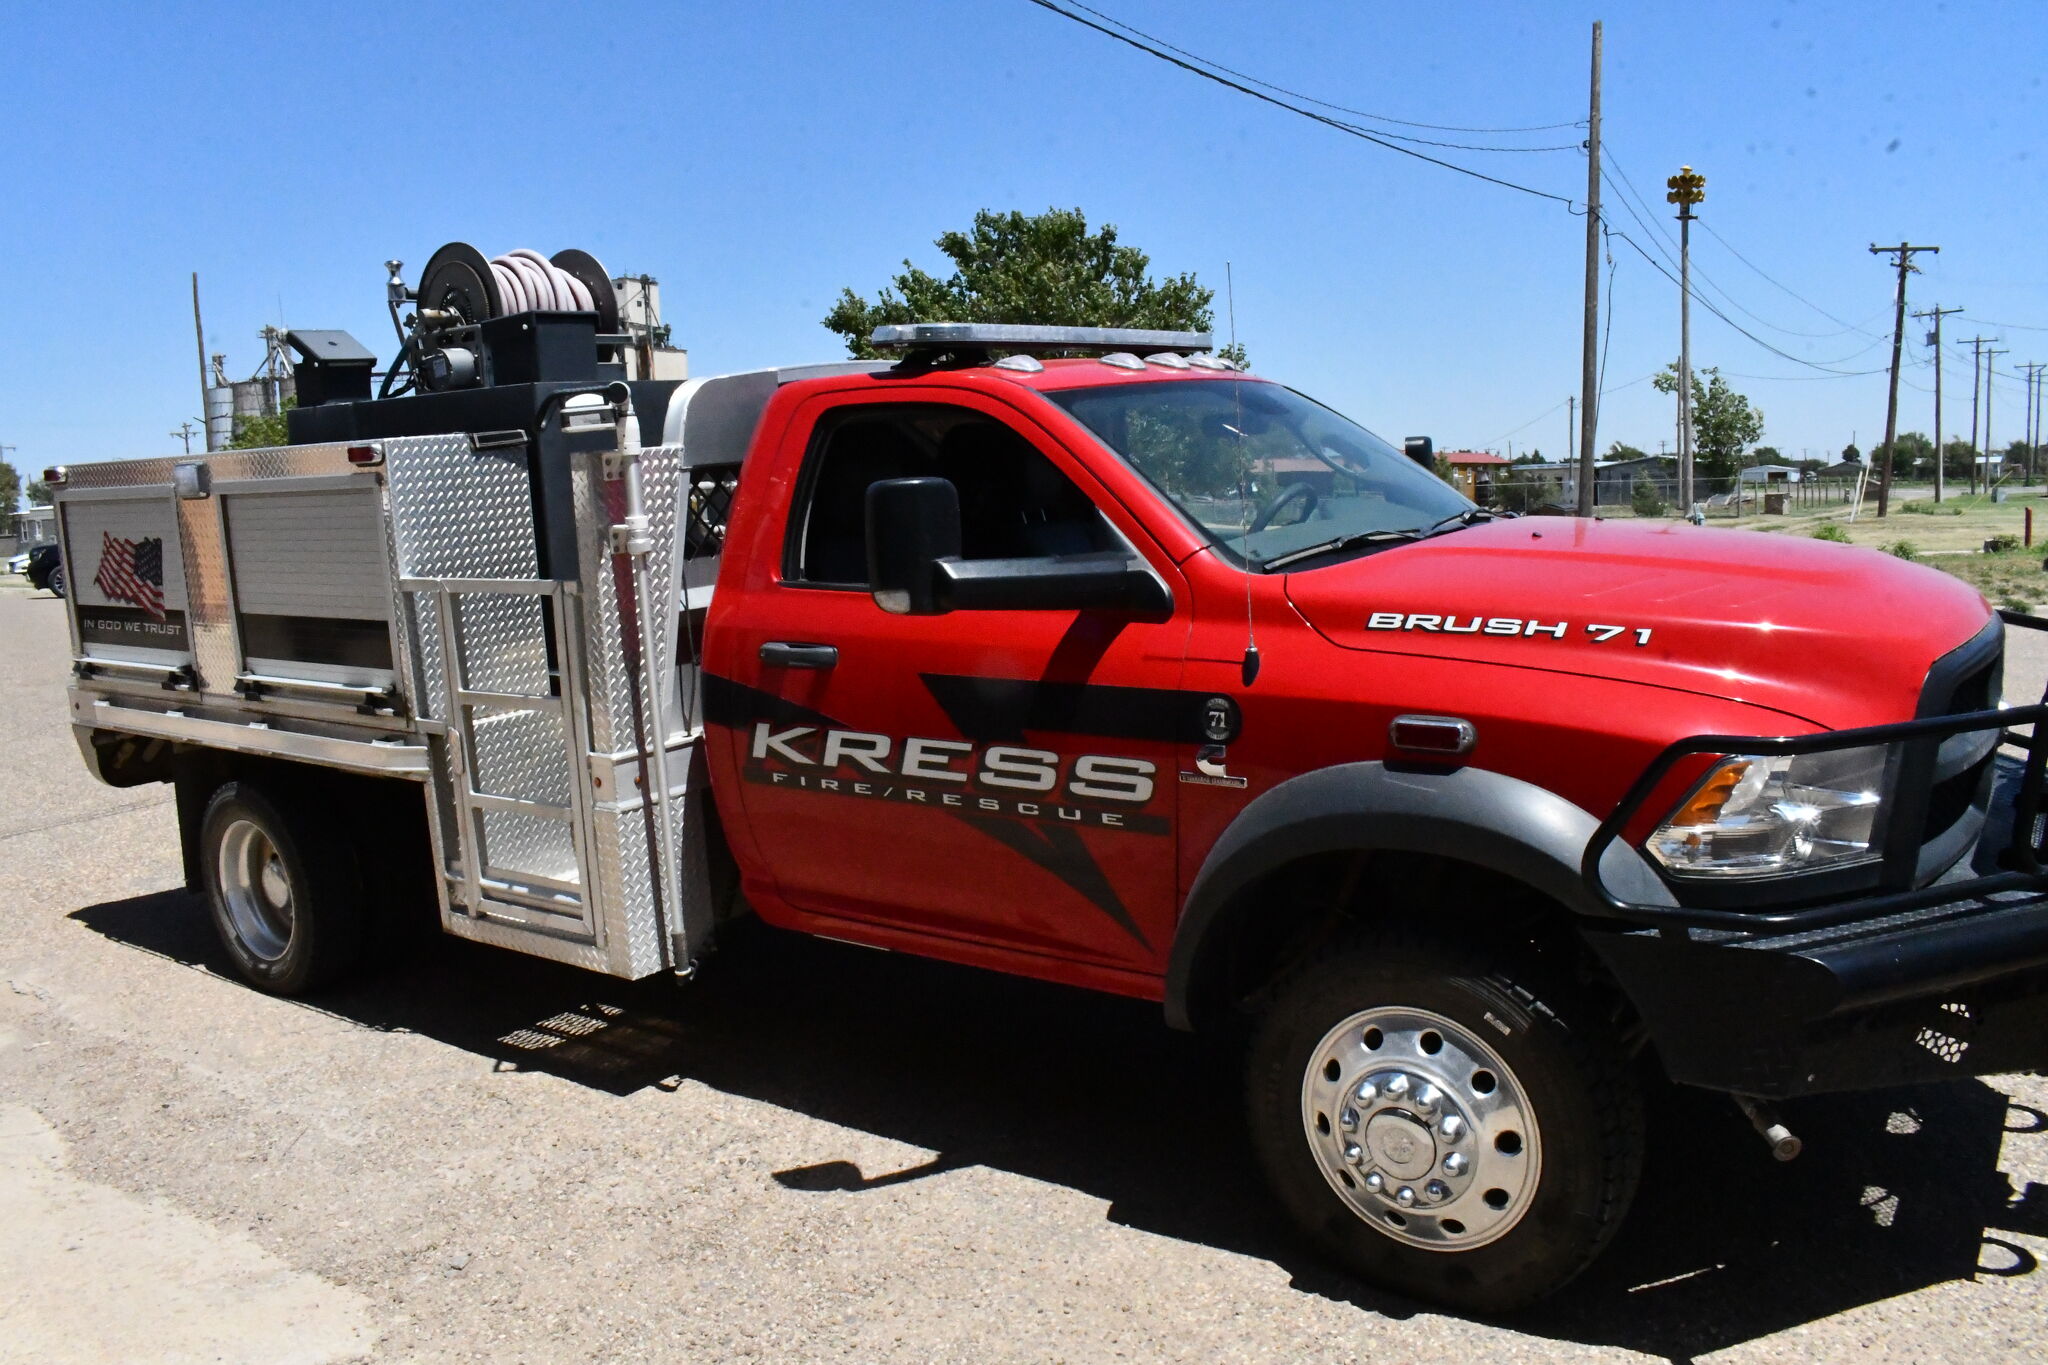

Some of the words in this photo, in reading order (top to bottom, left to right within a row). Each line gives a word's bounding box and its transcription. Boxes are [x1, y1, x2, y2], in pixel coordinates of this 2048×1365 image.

[84, 619, 95, 629] IN
[97, 620, 121, 630] GOD
[124, 622, 141, 632] WE
[143, 622, 182, 635] TRUST
[1367, 612, 1568, 638] BRUSH
[1586, 623, 1653, 647] 71
[1208, 711, 1226, 728] 71
[752, 723, 1157, 802] KRESS
